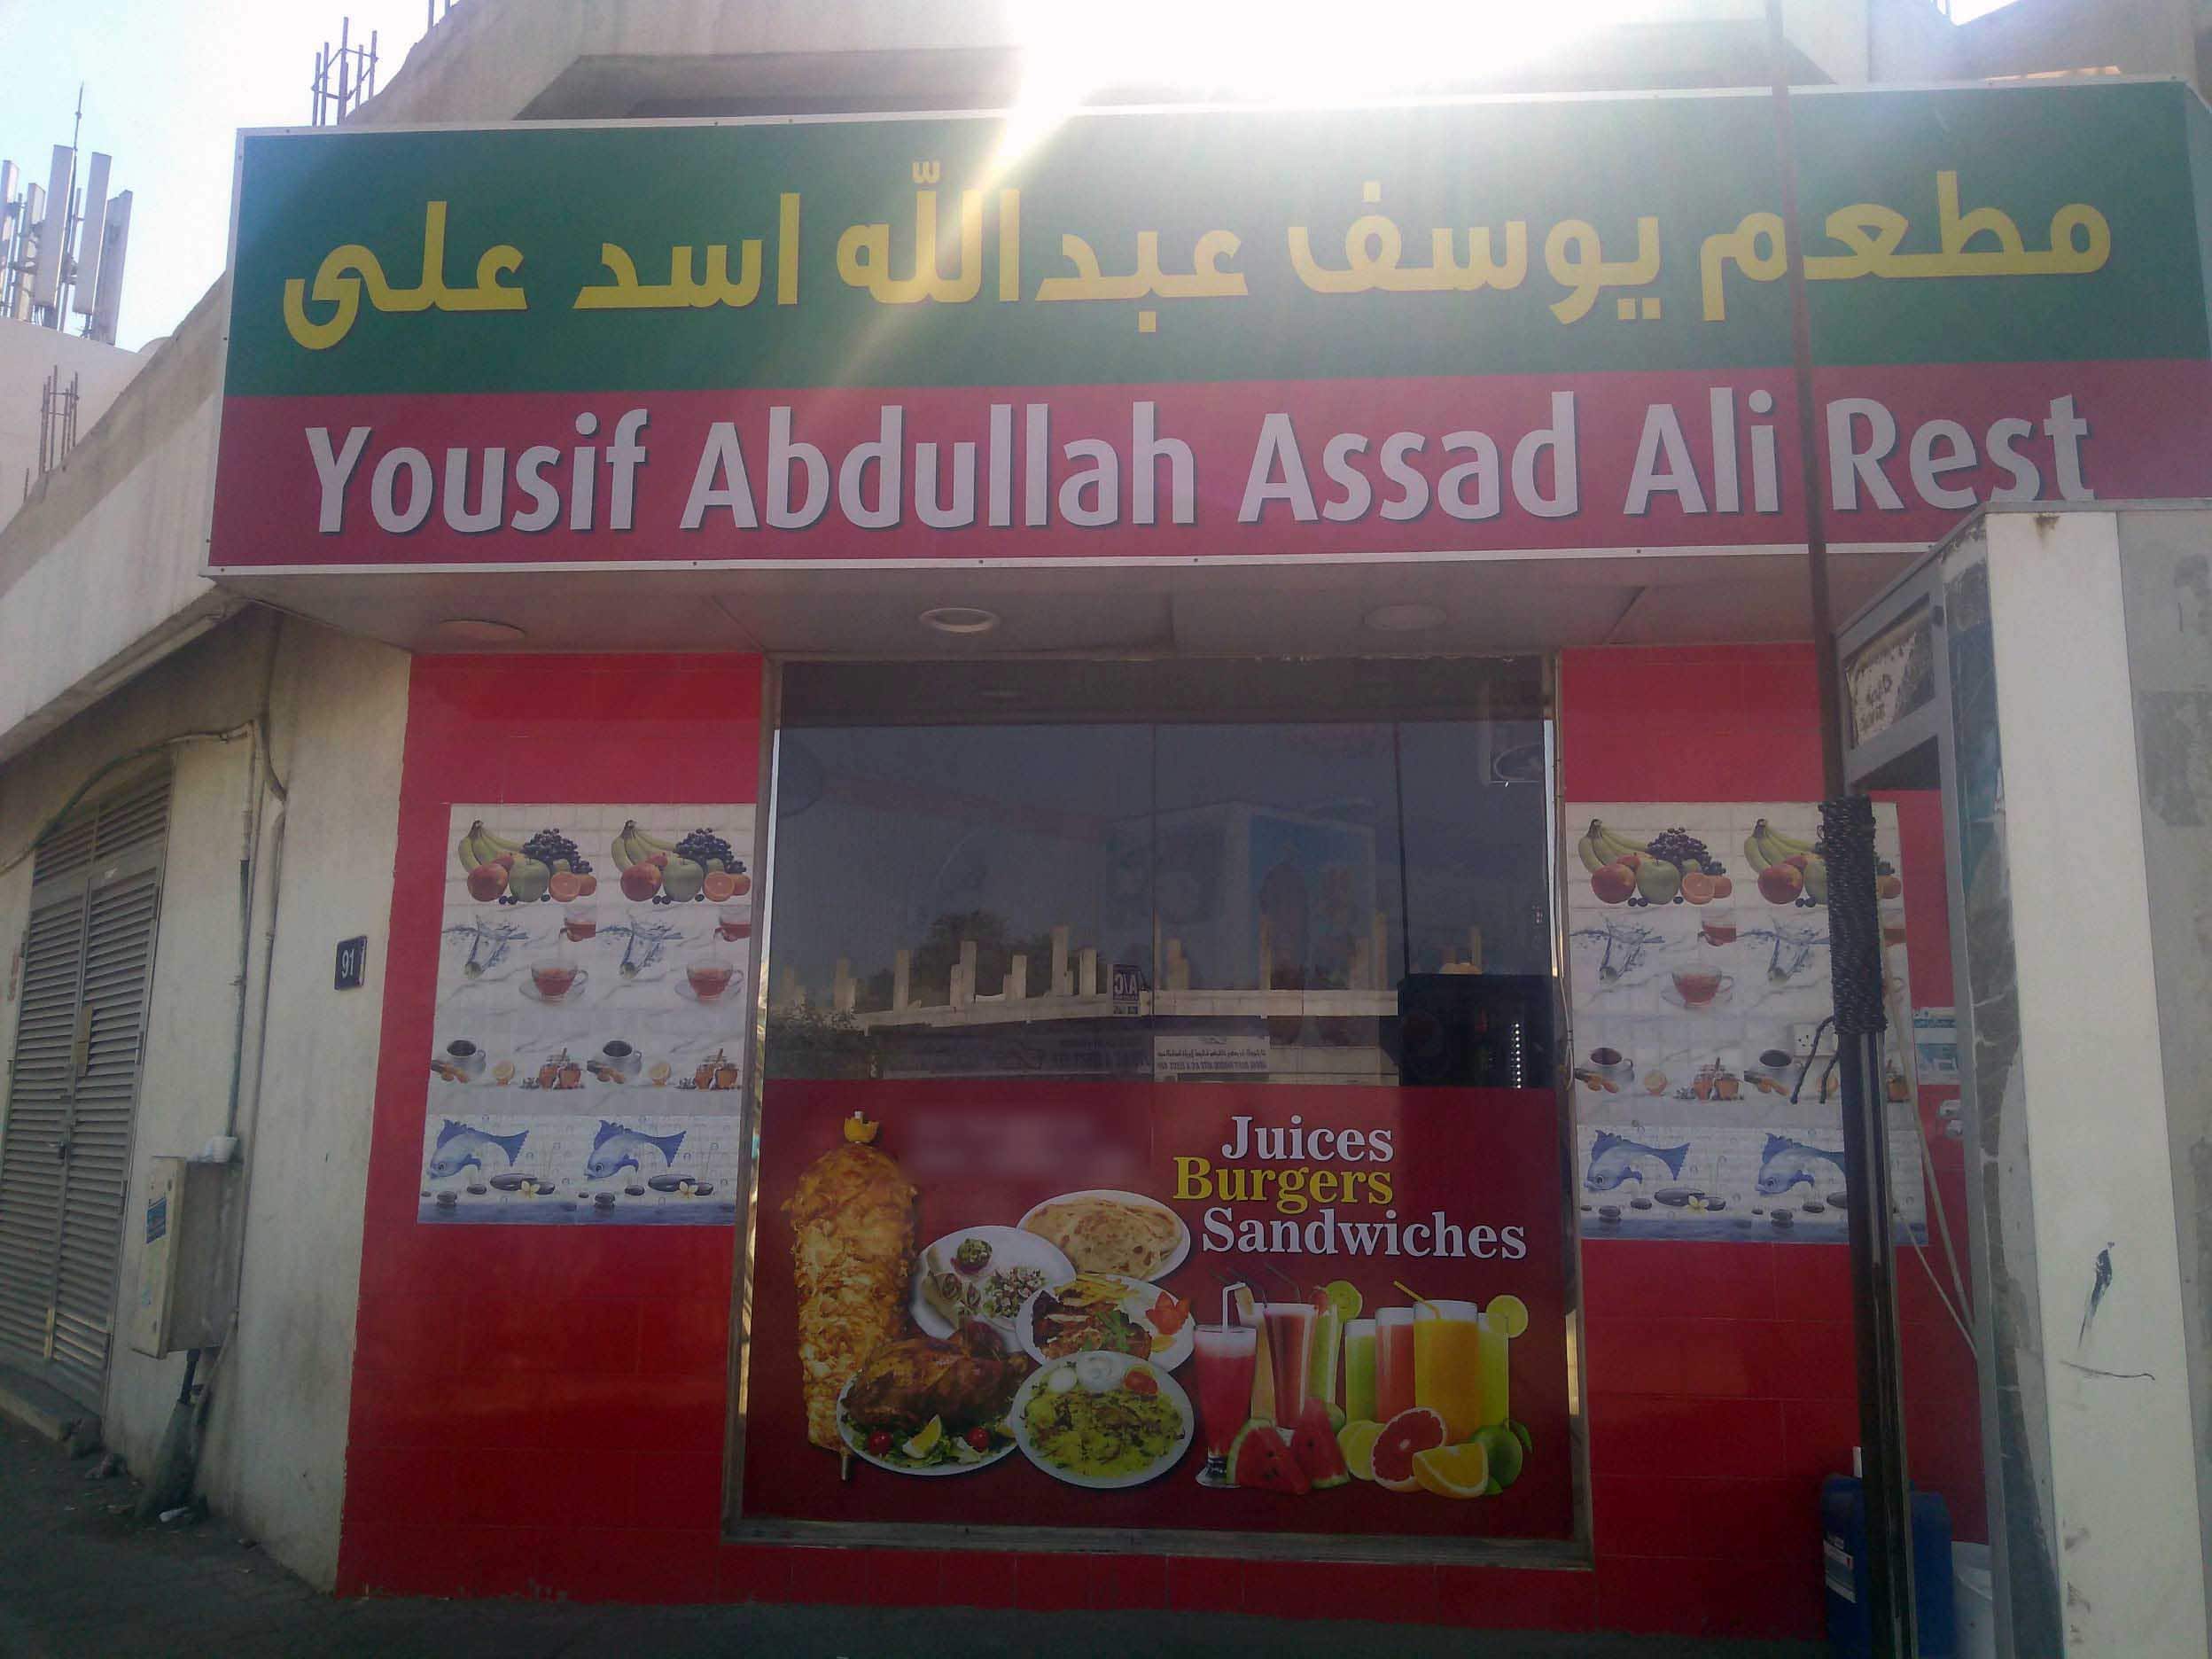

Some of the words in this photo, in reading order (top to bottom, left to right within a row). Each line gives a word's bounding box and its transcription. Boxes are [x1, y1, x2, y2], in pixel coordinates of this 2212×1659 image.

[574, 192, 801, 308] اسد
[1288, 182, 1662, 325] يوسف
[1701, 171, 2112, 321] مطعم
[305, 409, 649, 534] Yousif
[680, 402, 1195, 530] Abdullah
[1237, 391, 1580, 523] Assad
[1624, 386, 1780, 515] Ali
[1826, 393, 2095, 510] Rest
[341, 948, 355, 979] 91
[1221, 1114, 1395, 1163] Juices
[1172, 1156, 1394, 1214] Burgers
[1202, 1206, 1527, 1259] Sandwiches
